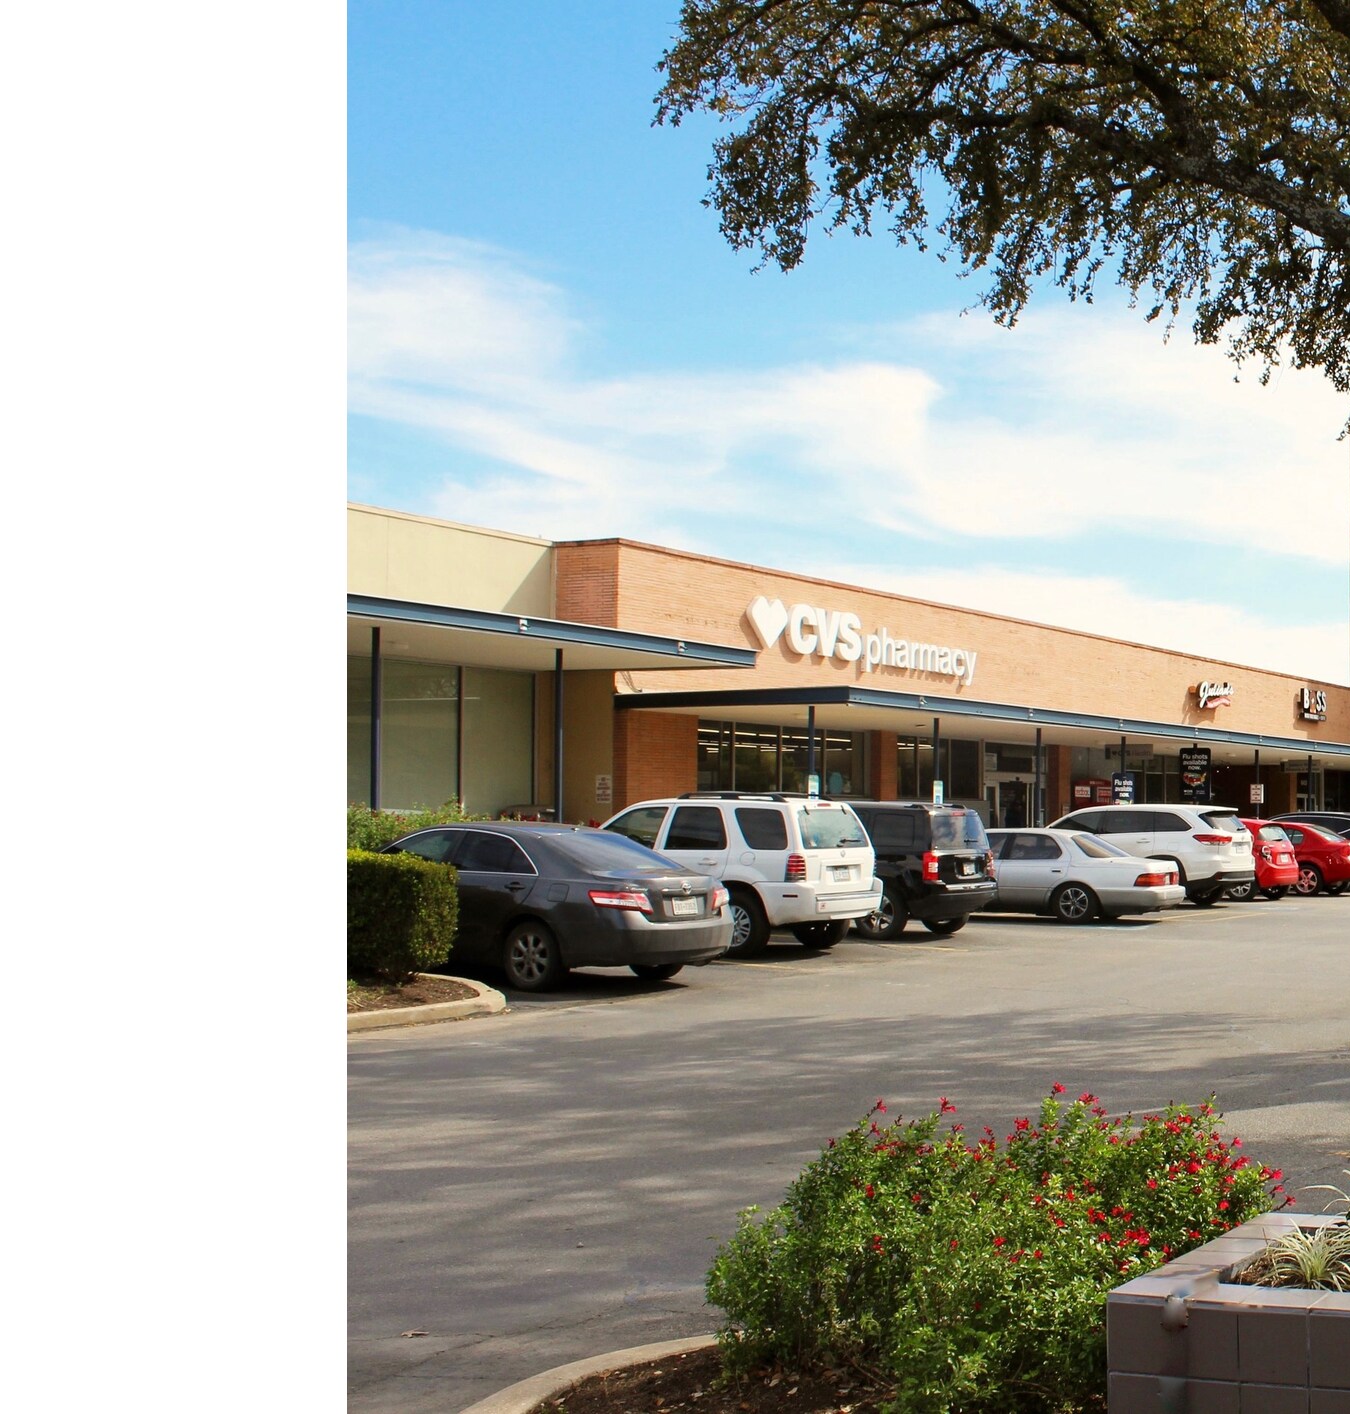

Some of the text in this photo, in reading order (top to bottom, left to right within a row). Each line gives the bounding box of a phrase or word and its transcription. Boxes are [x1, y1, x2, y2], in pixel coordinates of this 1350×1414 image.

[786, 603, 978, 687] CVS pharmacy
[1303, 688, 1327, 713] BSS
